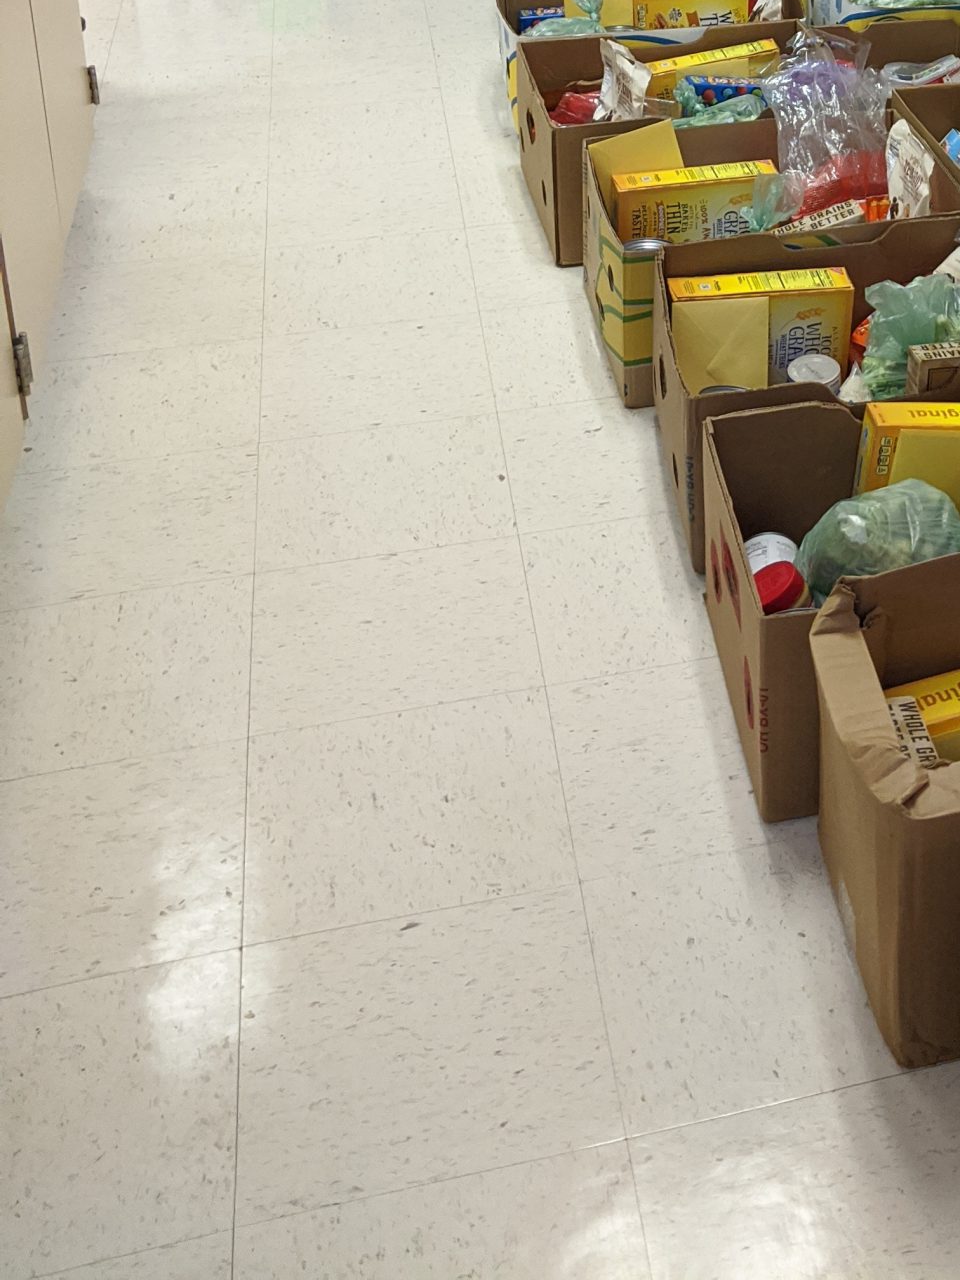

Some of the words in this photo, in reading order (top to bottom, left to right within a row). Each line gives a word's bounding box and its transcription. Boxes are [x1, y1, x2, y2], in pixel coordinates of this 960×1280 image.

[632, 208, 641, 239] TASTE
[667, 202, 681, 234] THIN
[681, 203, 689, 233] BAKED
[809, 201, 853, 221] GRAINS
[810, 208, 855, 230] BETTER
[898, 701, 930, 749] WHOLE
